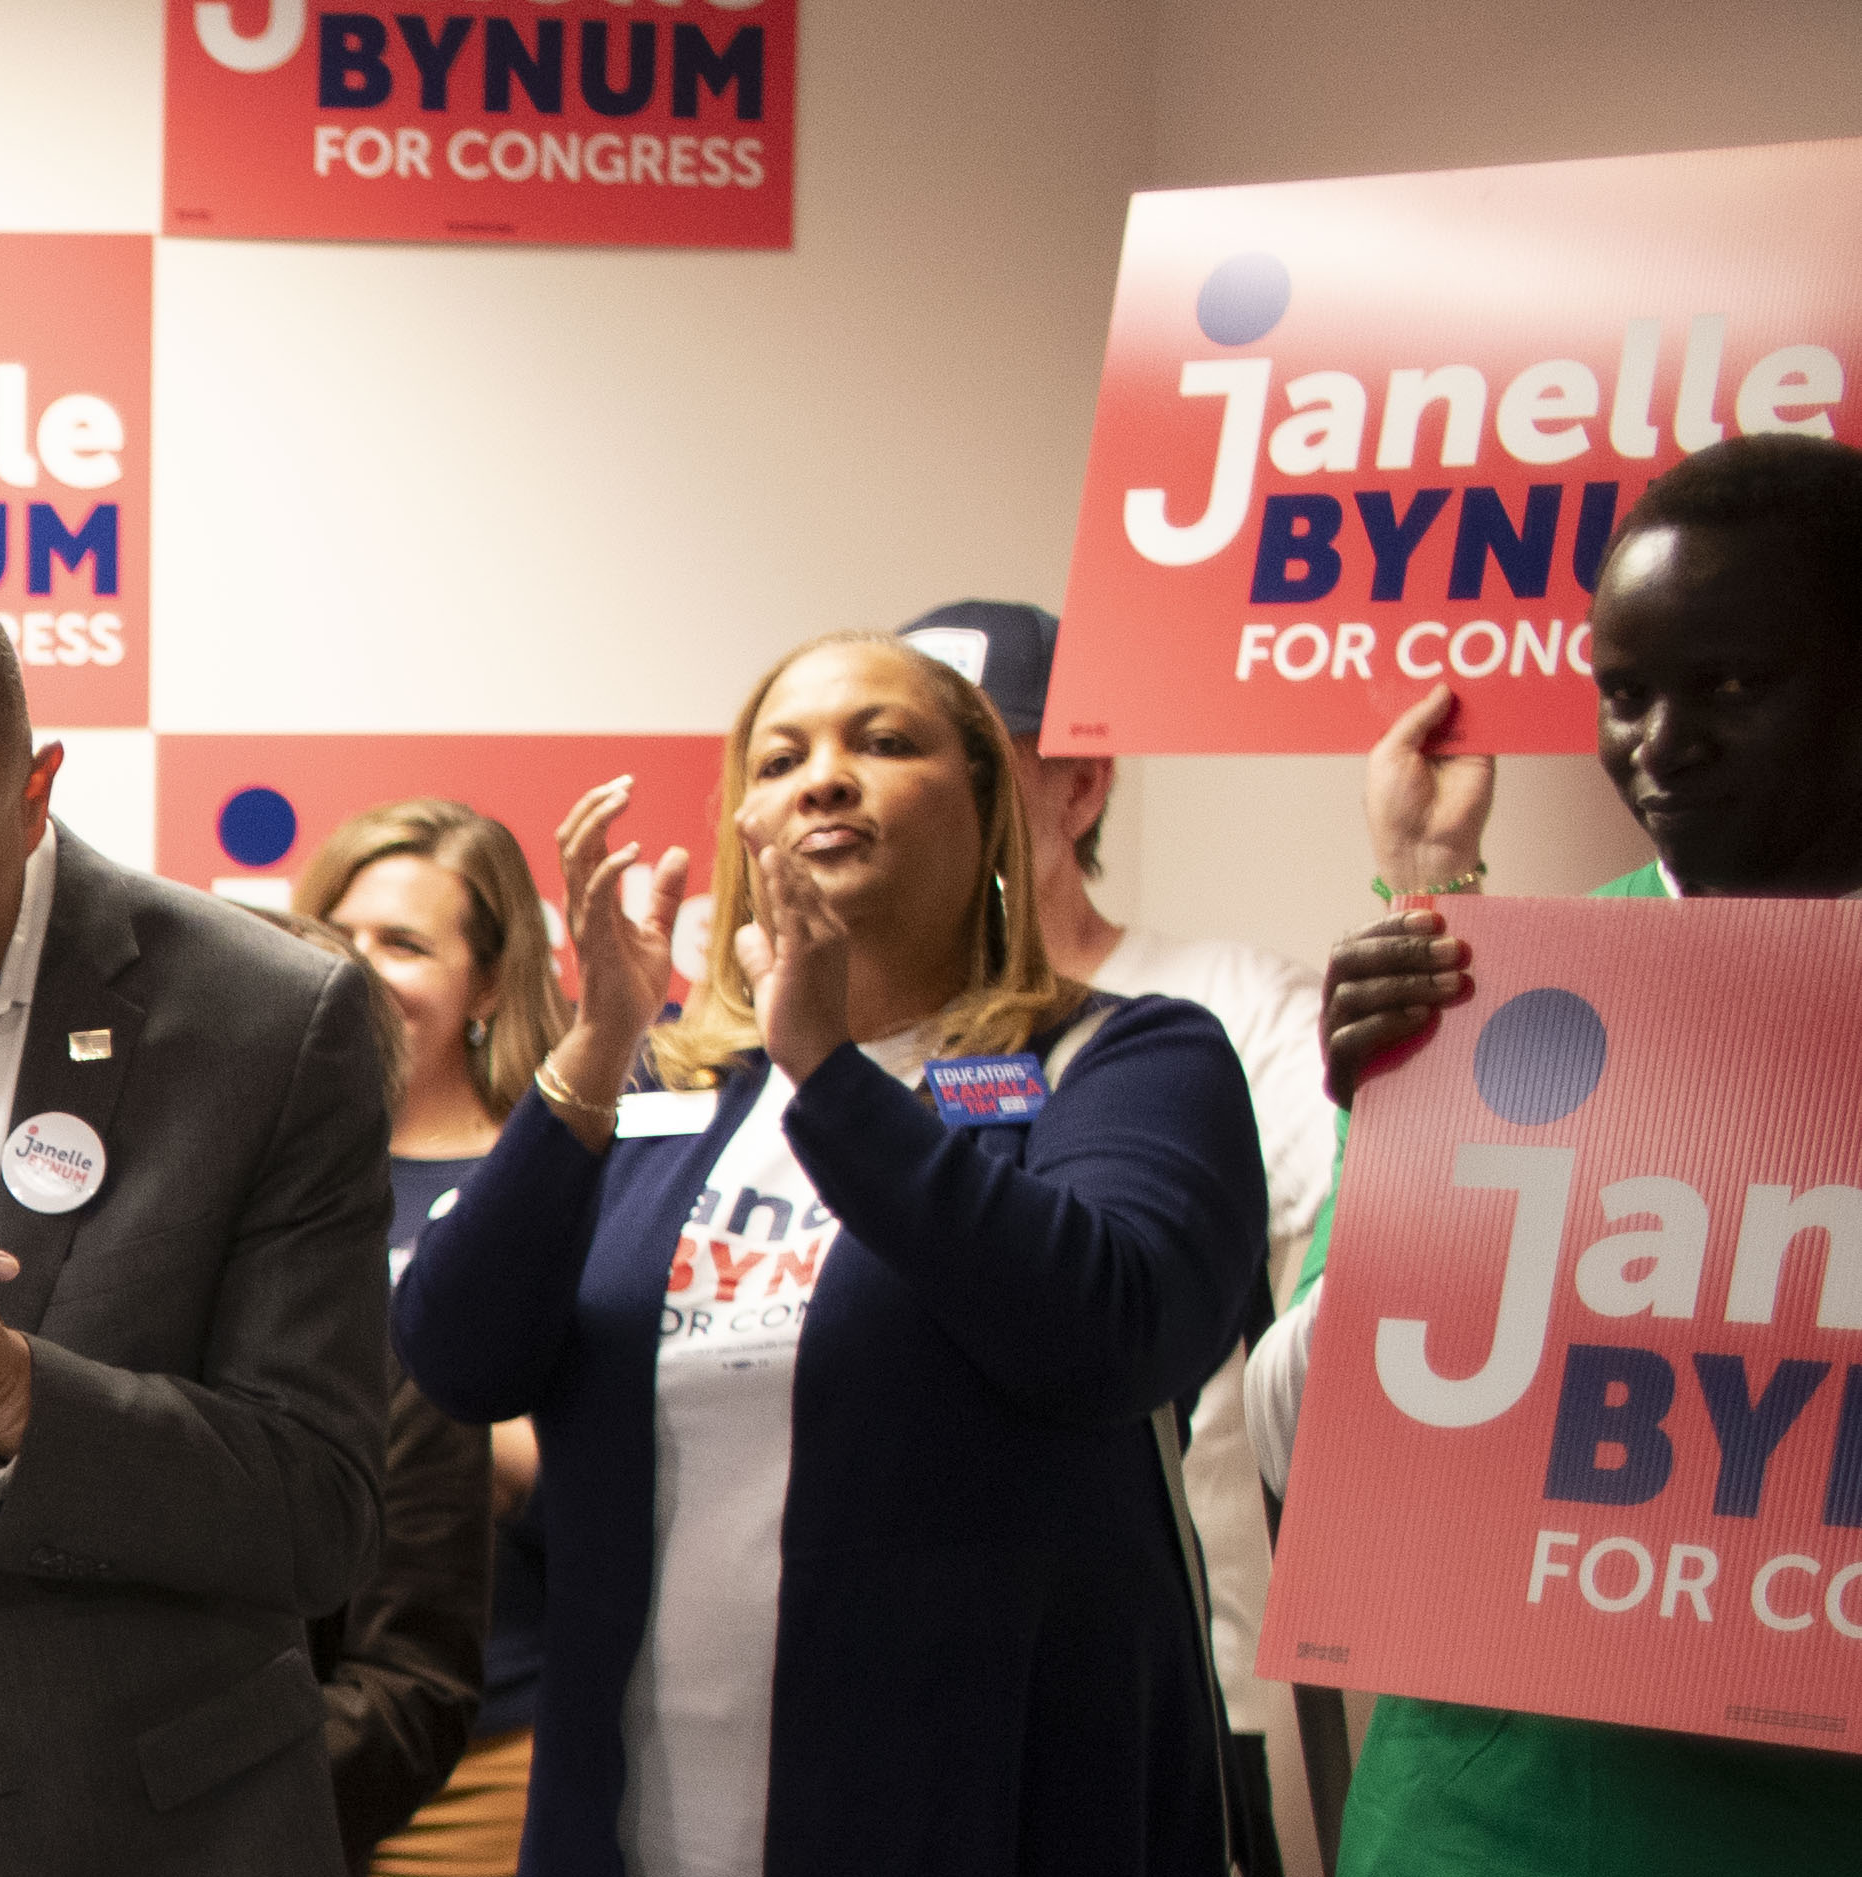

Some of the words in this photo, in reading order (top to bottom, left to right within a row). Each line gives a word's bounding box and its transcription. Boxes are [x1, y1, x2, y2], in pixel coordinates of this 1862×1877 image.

[316, 14, 765, 120] BYNUM
[314, 126, 432, 179] FOR
[446, 128, 765, 188] CONGRESS
[1250, 480, 1619, 604] BYN
[1235, 622, 1377, 682] FOR
[940, 1077, 1044, 1103] KAMALA
[1524, 1529, 1720, 1623] FOR
